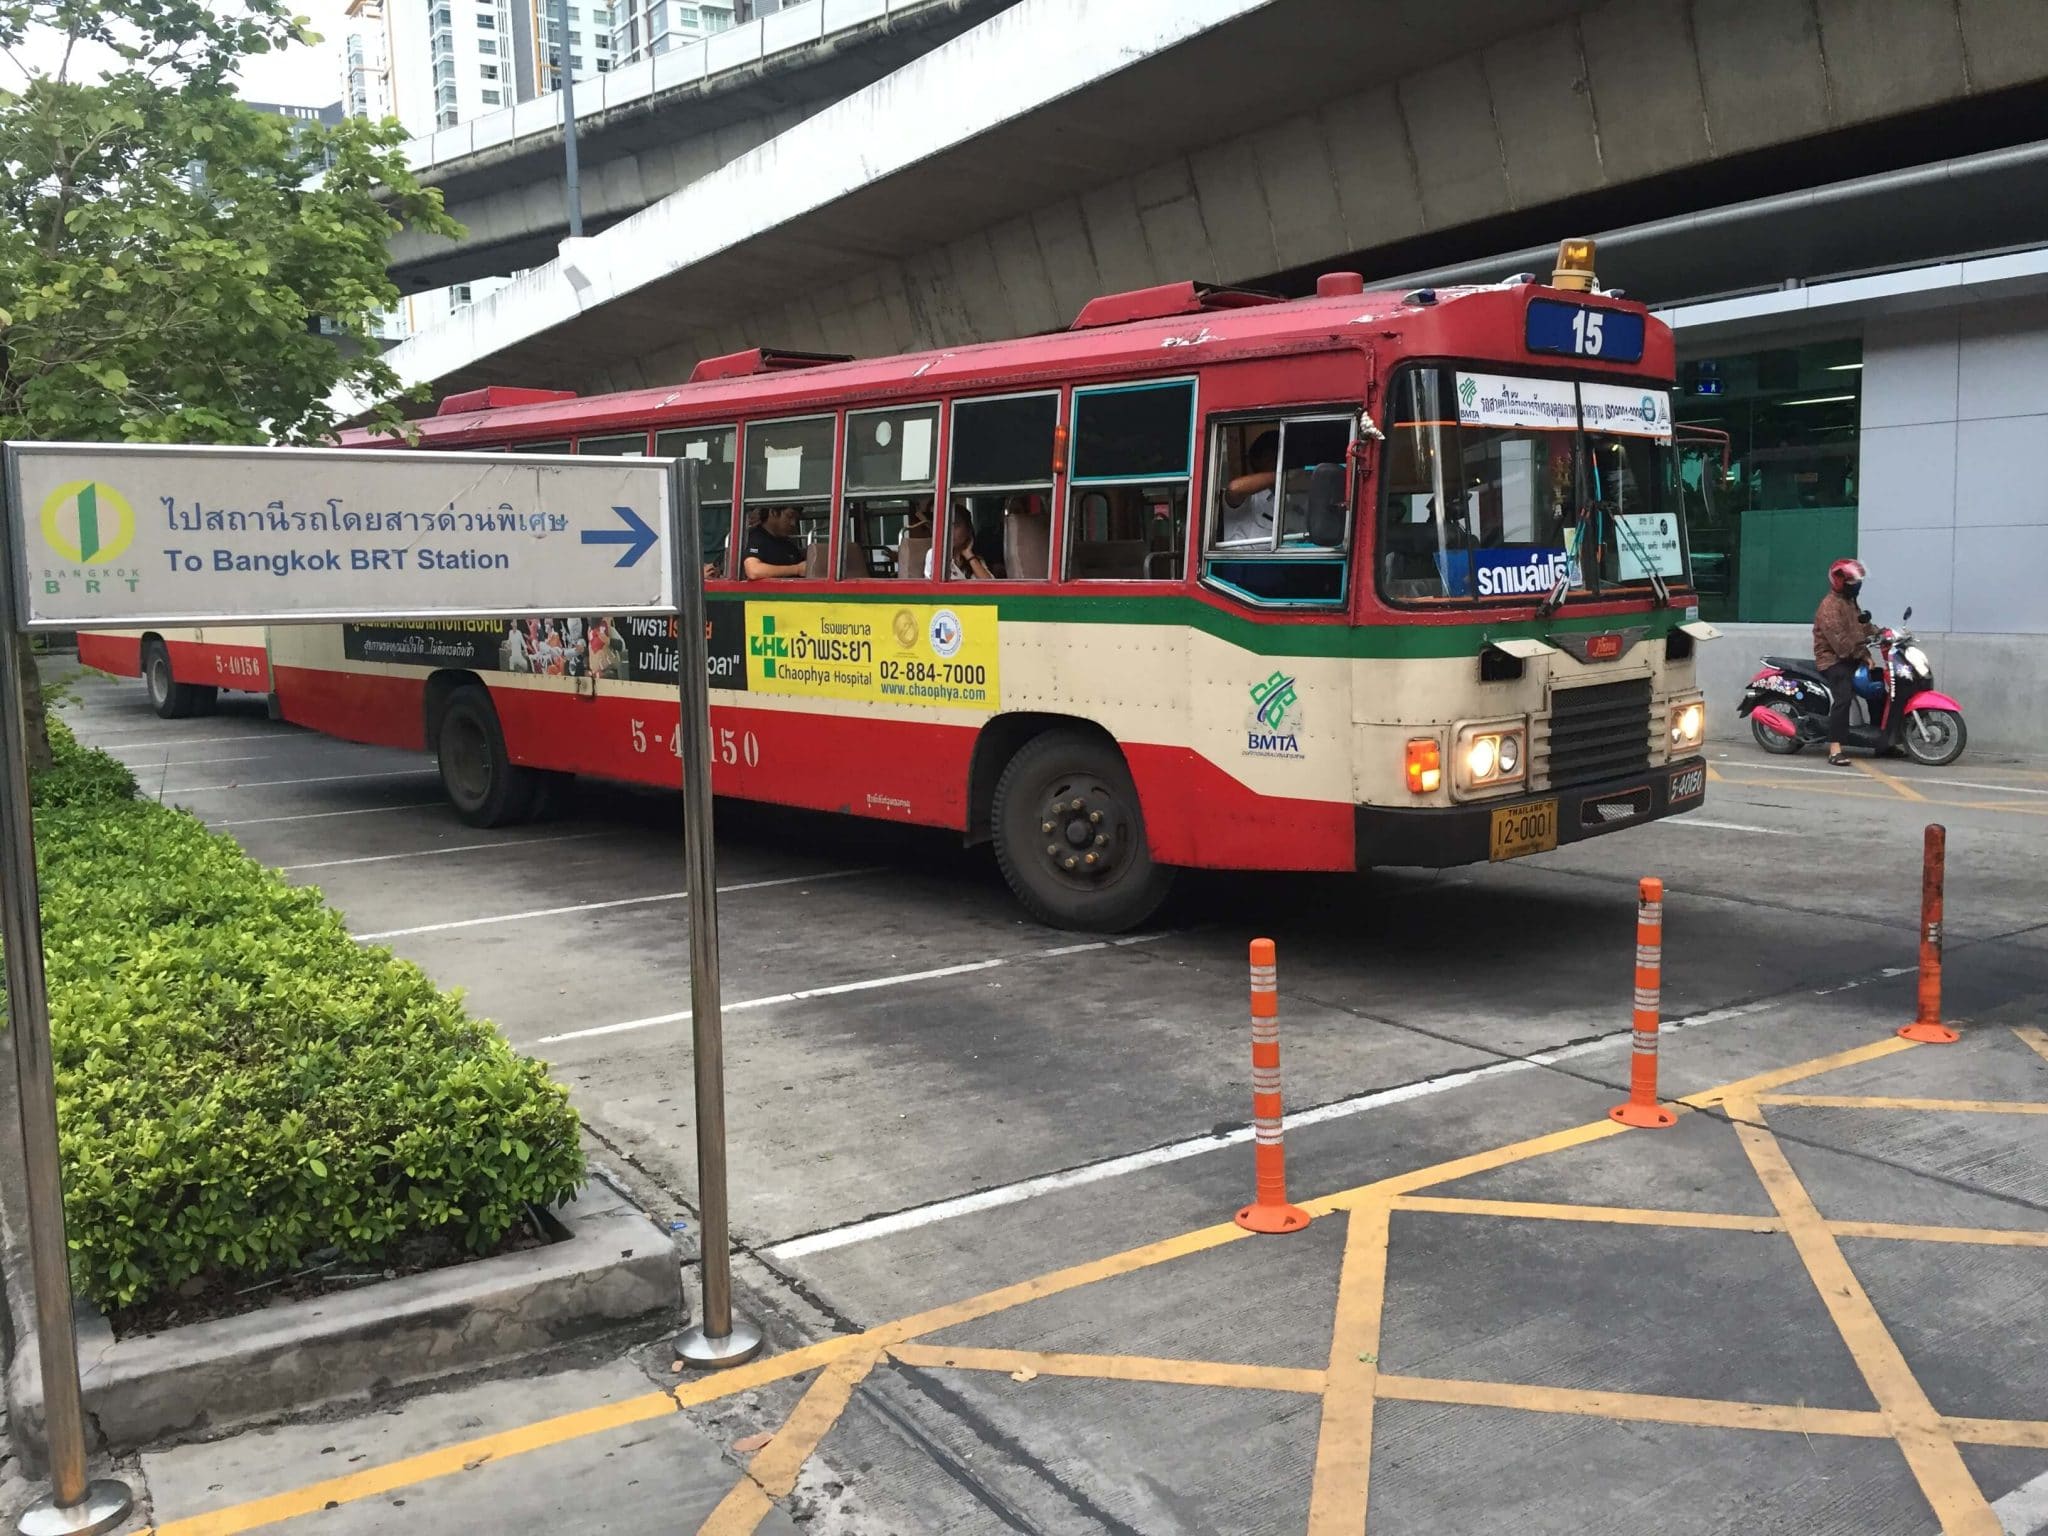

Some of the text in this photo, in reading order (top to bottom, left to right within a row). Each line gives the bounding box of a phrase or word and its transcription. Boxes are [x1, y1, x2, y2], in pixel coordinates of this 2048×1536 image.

[1573, 309, 1603, 355] 15
[1460, 409, 1480, 419] BMTA
[160, 496, 569, 534] ไปสถานีรถโดยสารด่วนพิเศษ
[44, 568, 140, 578] BANGKOK
[163, 549, 510, 576] To Bangkok BRT Station
[1477, 552, 1567, 595] รถเมล์ฟรี
[45, 579, 140, 595] BRT
[821, 617, 871, 636] โรงพยาบาล
[790, 631, 872, 662] เจ้าพระยา
[778, 664, 873, 687] Chaophya Hospital
[880, 661, 986, 685] 02-884-7000
[881, 682, 986, 700] www.chaophya.com
[631, 718, 760, 768] 5-4150
[1247, 733, 1299, 752] BMTA
